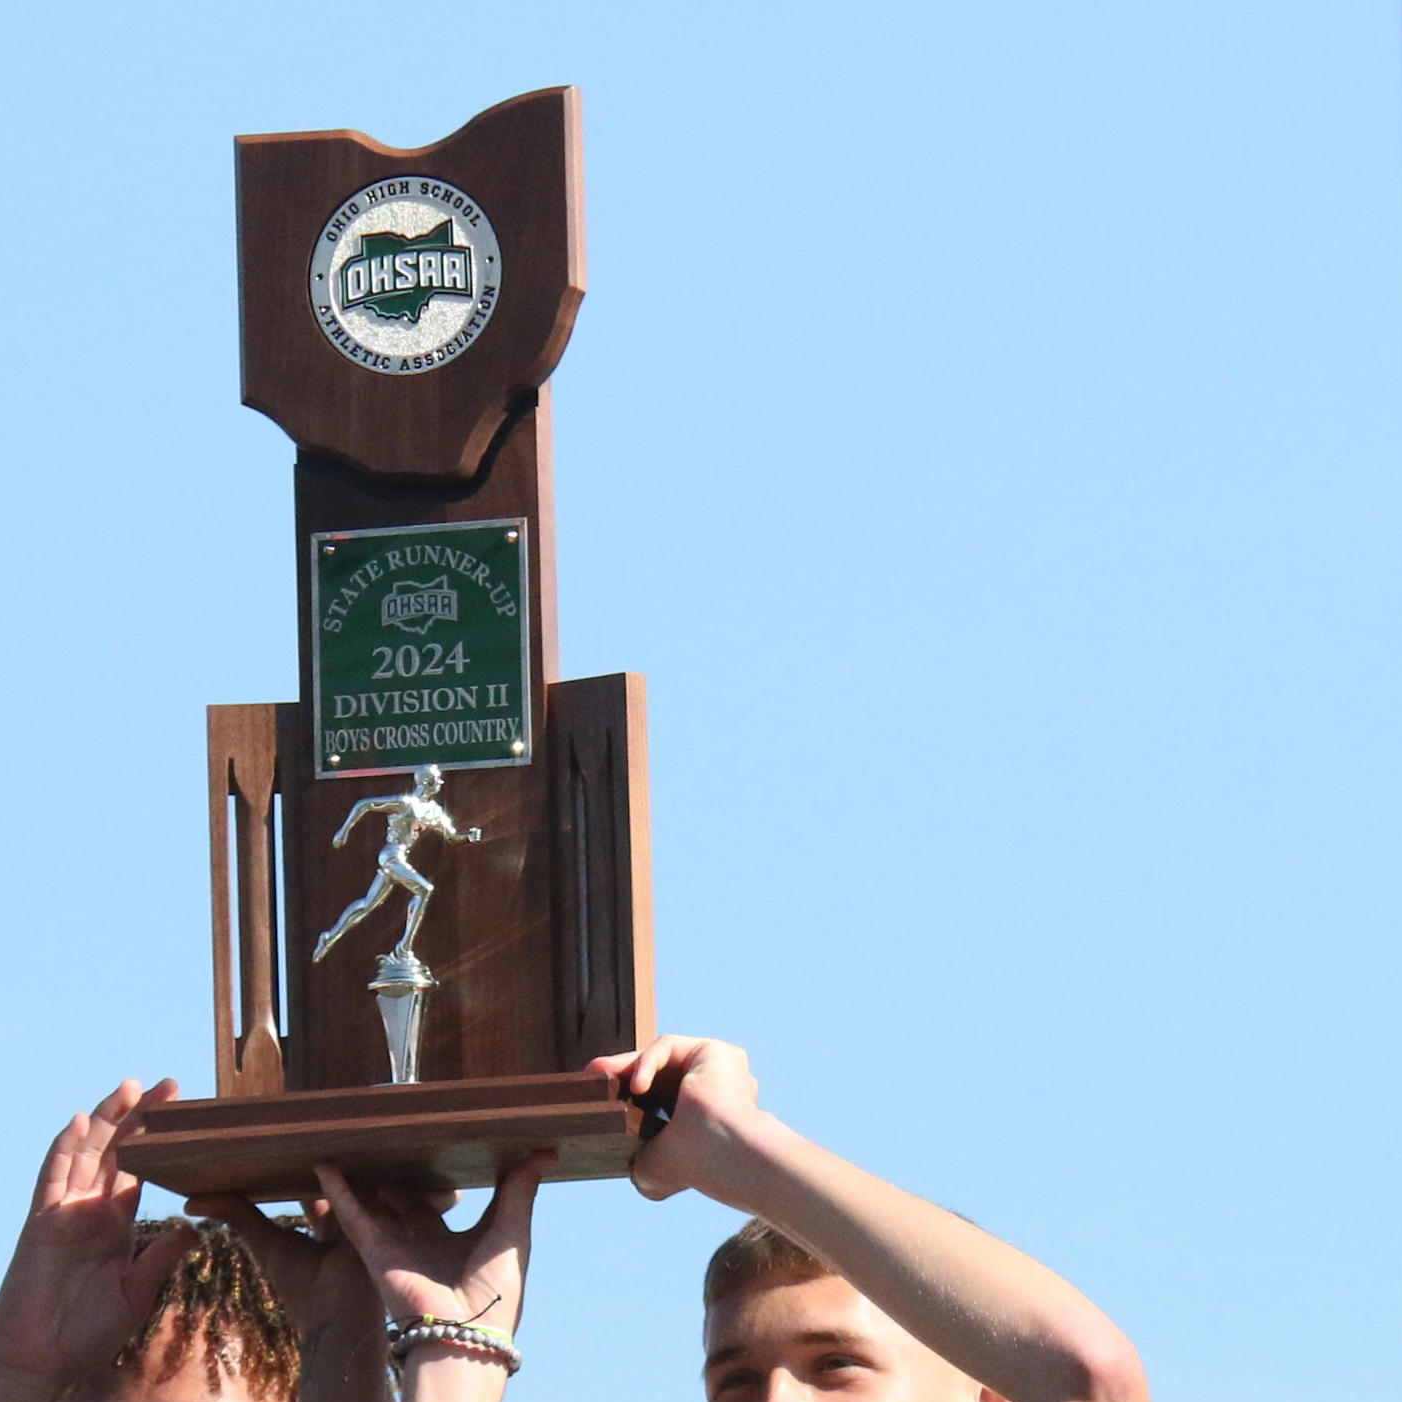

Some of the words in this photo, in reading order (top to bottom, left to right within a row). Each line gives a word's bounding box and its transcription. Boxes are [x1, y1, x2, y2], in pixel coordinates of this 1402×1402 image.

[326, 203, 360, 242] OHIO
[366, 181, 410, 205] HIGH
[421, 182, 482, 228] SCHOOL
[347, 251, 467, 300] OHSAA
[319, 304, 391, 370] ATHLETIC
[399, 285, 496, 371] ASSOCIATION
[323, 559, 385, 633] STATE
[387, 545, 517, 617] RUNNER-UP
[386, 590, 453, 618] OHSAA
[370, 641, 470, 680] 2024
[333, 685, 479, 719] DIVISION
[486, 684, 510, 708] II
[325, 728, 370, 754] BOYS
[373, 723, 429, 749] CROSS
[433, 717, 520, 745] COUNTRY
